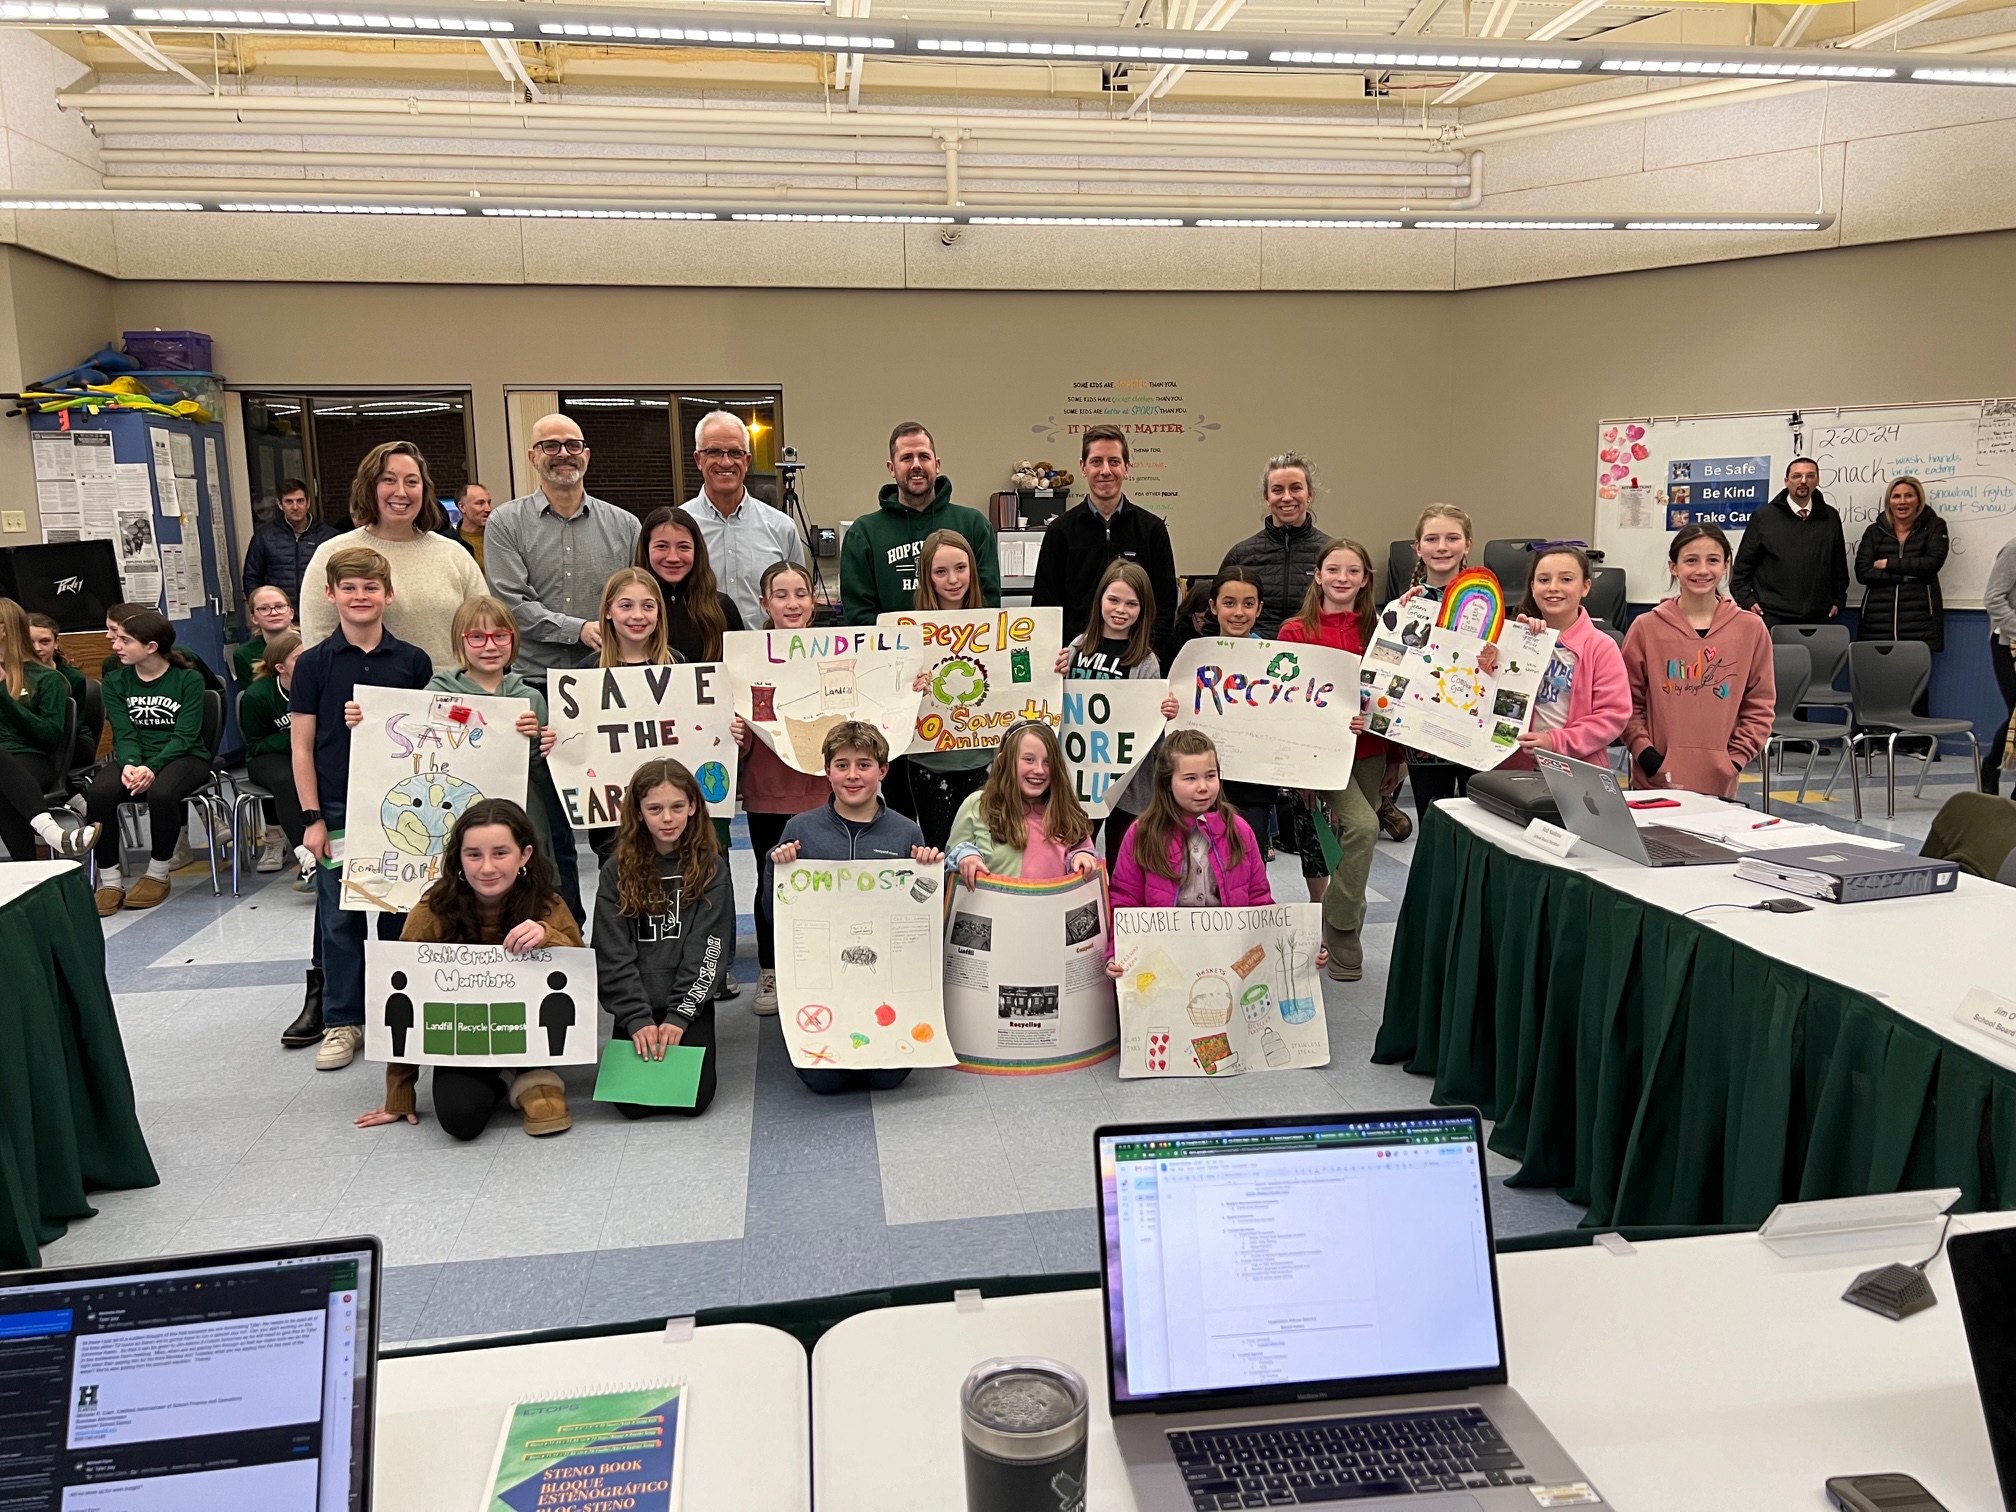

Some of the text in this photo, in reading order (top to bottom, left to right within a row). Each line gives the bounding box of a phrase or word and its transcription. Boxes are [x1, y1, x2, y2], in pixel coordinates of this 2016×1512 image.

[1131, 406, 1160, 416] SPORTS
[1068, 424, 1080, 435] IT
[1818, 423, 1900, 449] 2-20-24
[1928, 451, 1963, 463] hands
[1704, 463, 1757, 476] Be Safe
[1816, 453, 1888, 490] Snack
[1891, 463, 1956, 477] before eating
[1702, 485, 1756, 499] Be Kind
[1982, 484, 2014, 501] fights
[1695, 511, 1752, 523] Take Car
[1938, 500, 2007, 513] next Snow
[765, 632, 911, 665] LANDFILL
[1077, 651, 1123, 677] WILL
[1666, 649, 1703, 680] Kind
[557, 664, 717, 720] SAVE
[1194, 664, 1336, 716] Recycle
[1674, 683, 1683, 696] by
[950, 706, 1016, 732] Save
[1018, 698, 1063, 727] the
[1063, 692, 1111, 726] NO
[596, 719, 680, 754] THE
[413, 752, 450, 774] The
[382, 851, 442, 882] Eart
[776, 867, 915, 905] COMPOST
[1115, 905, 1293, 937] REUSABLE FOOD STORAGE
[417, 943, 456, 964] Sixth
[456, 945, 504, 966] Grade
[434, 968, 517, 993] Warriors
[1195, 967, 1227, 978] BASKETS
[1993, 1006, 2010, 1018] Jim
[425, 1020, 527, 1034] Landfill Recycle Compost
[1009, 1021, 1042, 1029] Recycling
[1972, 1013, 2016, 1037] School Board
[536, 1404, 579, 1413] TOPS
[543, 1460, 642, 1480] STENO BOOK
[537, 1480, 668, 1505] ESTENOGRÁFICO
[539, 1476, 604, 1495] BLOQUE
